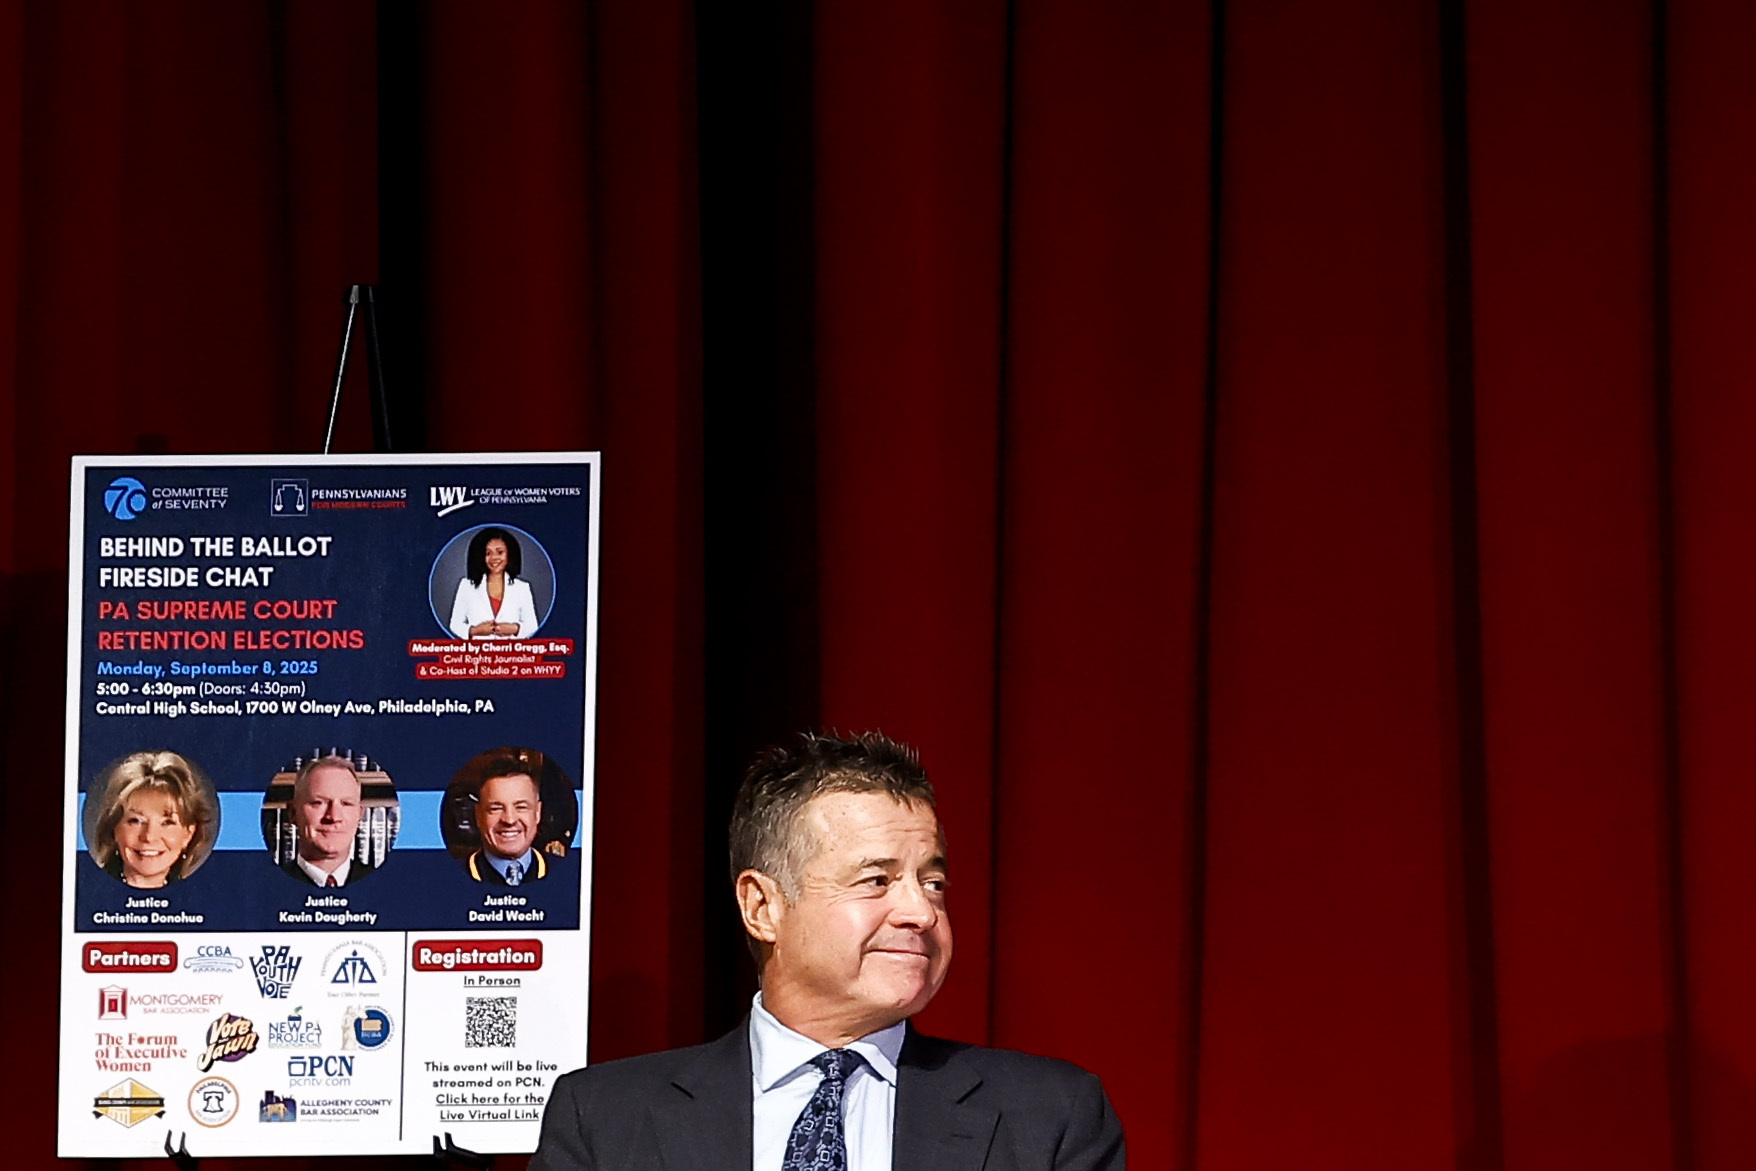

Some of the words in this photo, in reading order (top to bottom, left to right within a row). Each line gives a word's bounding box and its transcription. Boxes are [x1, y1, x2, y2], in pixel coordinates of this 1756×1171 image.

[152, 487, 229, 498] COMMITTEE
[311, 488, 407, 499] PENNSYLVANIANS
[470, 488, 502, 496] LEAGUE
[152, 499, 162, 509] of
[164, 499, 227, 509] SEVENTY
[100, 537, 184, 557] BEHIND
[190, 537, 234, 557] THE
[241, 536, 332, 556] BALLOT
[100, 567, 199, 587] FIRESIDE
[205, 567, 274, 587] CHAT
[99, 601, 129, 620] PA
[136, 601, 246, 620] SUPREME
[253, 600, 338, 619] COURT
[98, 631, 228, 650] RETENTION
[234, 630, 365, 649] ELECTIONS
[412, 643, 466, 652] Moderated
[468, 643, 480, 654] by
[482, 643, 512, 652] Cherri
[549, 643, 570, 654] Esq.
[443, 655, 463, 663] Civil
[464, 655, 492, 665] Rights
[494, 654, 536, 663] Journalist
[97, 661, 166, 678] Monday,
[170, 661, 259, 678] September
[262, 661, 276, 677] 8,
[280, 661, 318, 675] 2025
[419, 666, 427, 675] &
[429, 666, 467, 675] Co-Host
[468, 665, 478, 675] of
[480, 666, 510, 675] Studio
[512, 666, 518, 675] 2
[520, 667, 532, 675] on
[533, 665, 562, 674] WHYY
[96, 682, 129, 695] 5:00
[142, 682, 196, 698] 6:30pm
[199, 681, 246, 698] (Doors:
[249, 681, 306, 698] 4:30pm)
[96, 701, 151, 715] Central
[153, 701, 187, 718] High
[190, 700, 243, 716] School,
[246, 701, 279, 714] 1700
[282, 701, 297, 714] W
[300, 700, 341, 717] Olney
[344, 700, 375, 716] Ave,
[378, 699, 471, 716] Philadelphia,
[475, 701, 495, 713] PA
[125, 897, 169, 908] Justice
[305, 895, 348, 907] Justice
[483, 895, 527, 906] Justice
[93, 912, 149, 924] Christine
[151, 912, 204, 924] Donohue
[279, 911, 313, 923] Kevin
[315, 911, 377, 925] Dougherty
[469, 910, 504, 922] David
[505, 909, 545, 922] Wecht
[197, 945, 232, 957] CCBA
[261, 945, 291, 965] PA
[89, 949, 171, 967] Partners
[420, 947, 535, 969] Registration
[250, 956, 303, 983] YOUTH
[464, 975, 475, 986] In
[478, 975, 521, 986] Person
[257, 977, 293, 999] VOTE
[130, 994, 223, 1005] MONTGOMERY
[209, 1013, 253, 1045] Vote
[269, 1022, 302, 1034] NEW
[95, 1033, 123, 1046] The
[269, 1033, 322, 1044] PROJECT
[95, 1045, 110, 1059] of
[114, 1046, 188, 1059] Executive
[197, 1031, 259, 1072] Jawn
[95, 1059, 152, 1072] Women
[308, 1055, 355, 1077] PCN
[424, 1061, 449, 1072] This
[453, 1062, 487, 1072] event
[491, 1061, 513, 1071] will
[517, 1061, 532, 1071] be
[536, 1060, 557, 1071] live
[289, 1077, 351, 1088] pcntv.com
[432, 1077, 493, 1087] streamed
[497, 1079, 512, 1087] on
[515, 1077, 545, 1087] PCN.
[436, 1093, 468, 1104] Click
[471, 1093, 500, 1104] here
[503, 1093, 521, 1103] for
[525, 1093, 544, 1103] the
[320, 1108, 379, 1116] ASSOCIATION
[440, 1110, 465, 1120] Live
[468, 1109, 511, 1120] Virtual
[515, 1109, 539, 1119] Link
